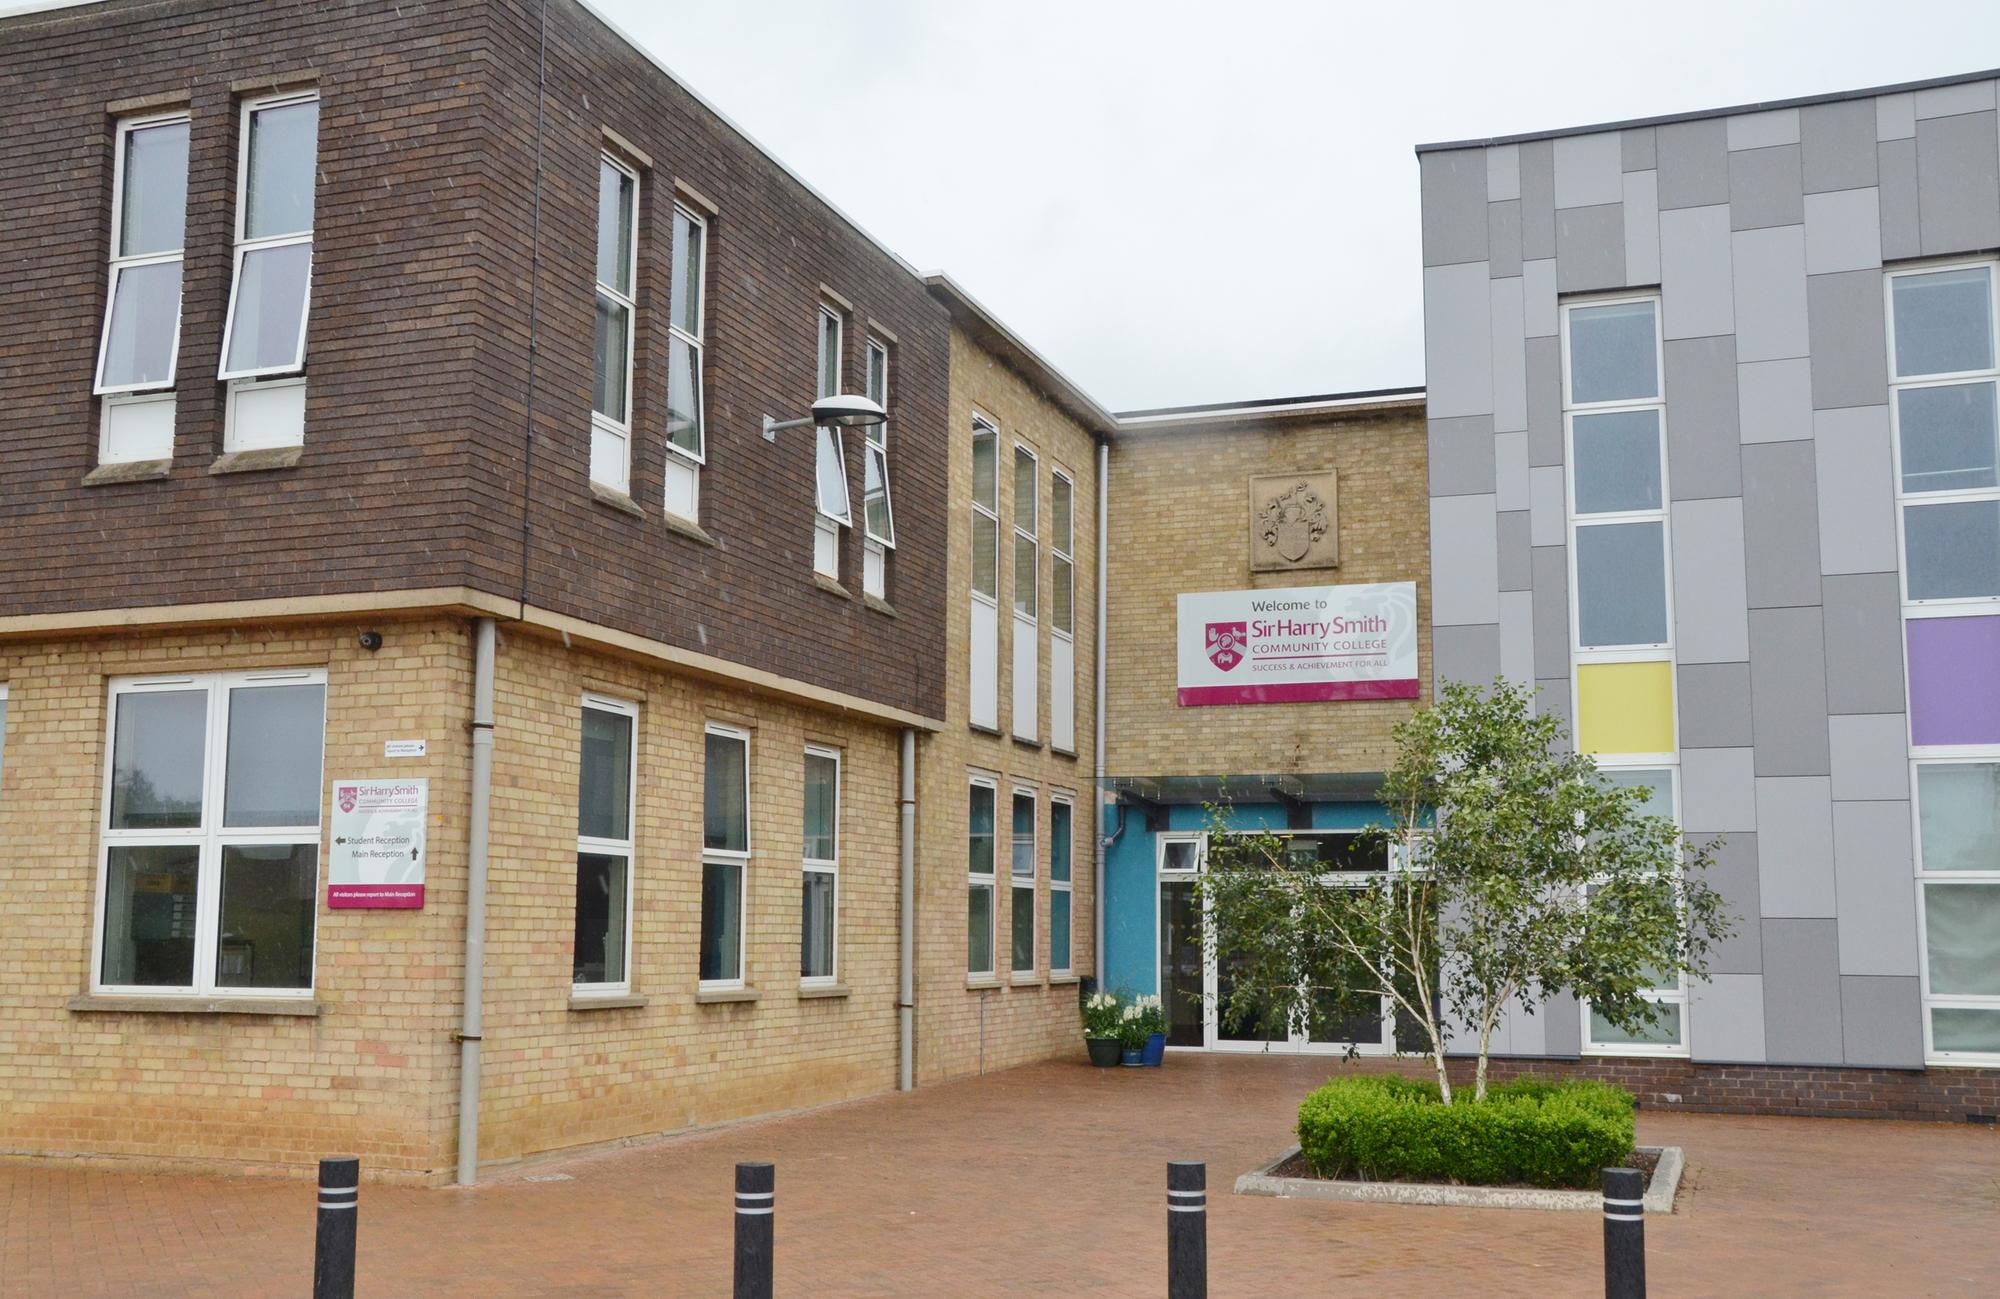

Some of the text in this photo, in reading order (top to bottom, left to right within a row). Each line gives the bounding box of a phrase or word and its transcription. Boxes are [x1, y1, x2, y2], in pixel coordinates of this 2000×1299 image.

[1252, 600, 1327, 612] Welcome to
[1252, 639, 1387, 654] COMMUNITY COLLEGE
[1252, 663, 1287, 671] SUCCESS
[1297, 661, 1353, 670] ACHIEVEMENT
[1354, 660, 1372, 668] FOR
[347, 836, 410, 845] Student Reception
[352, 850, 405, 859] Main Reception
